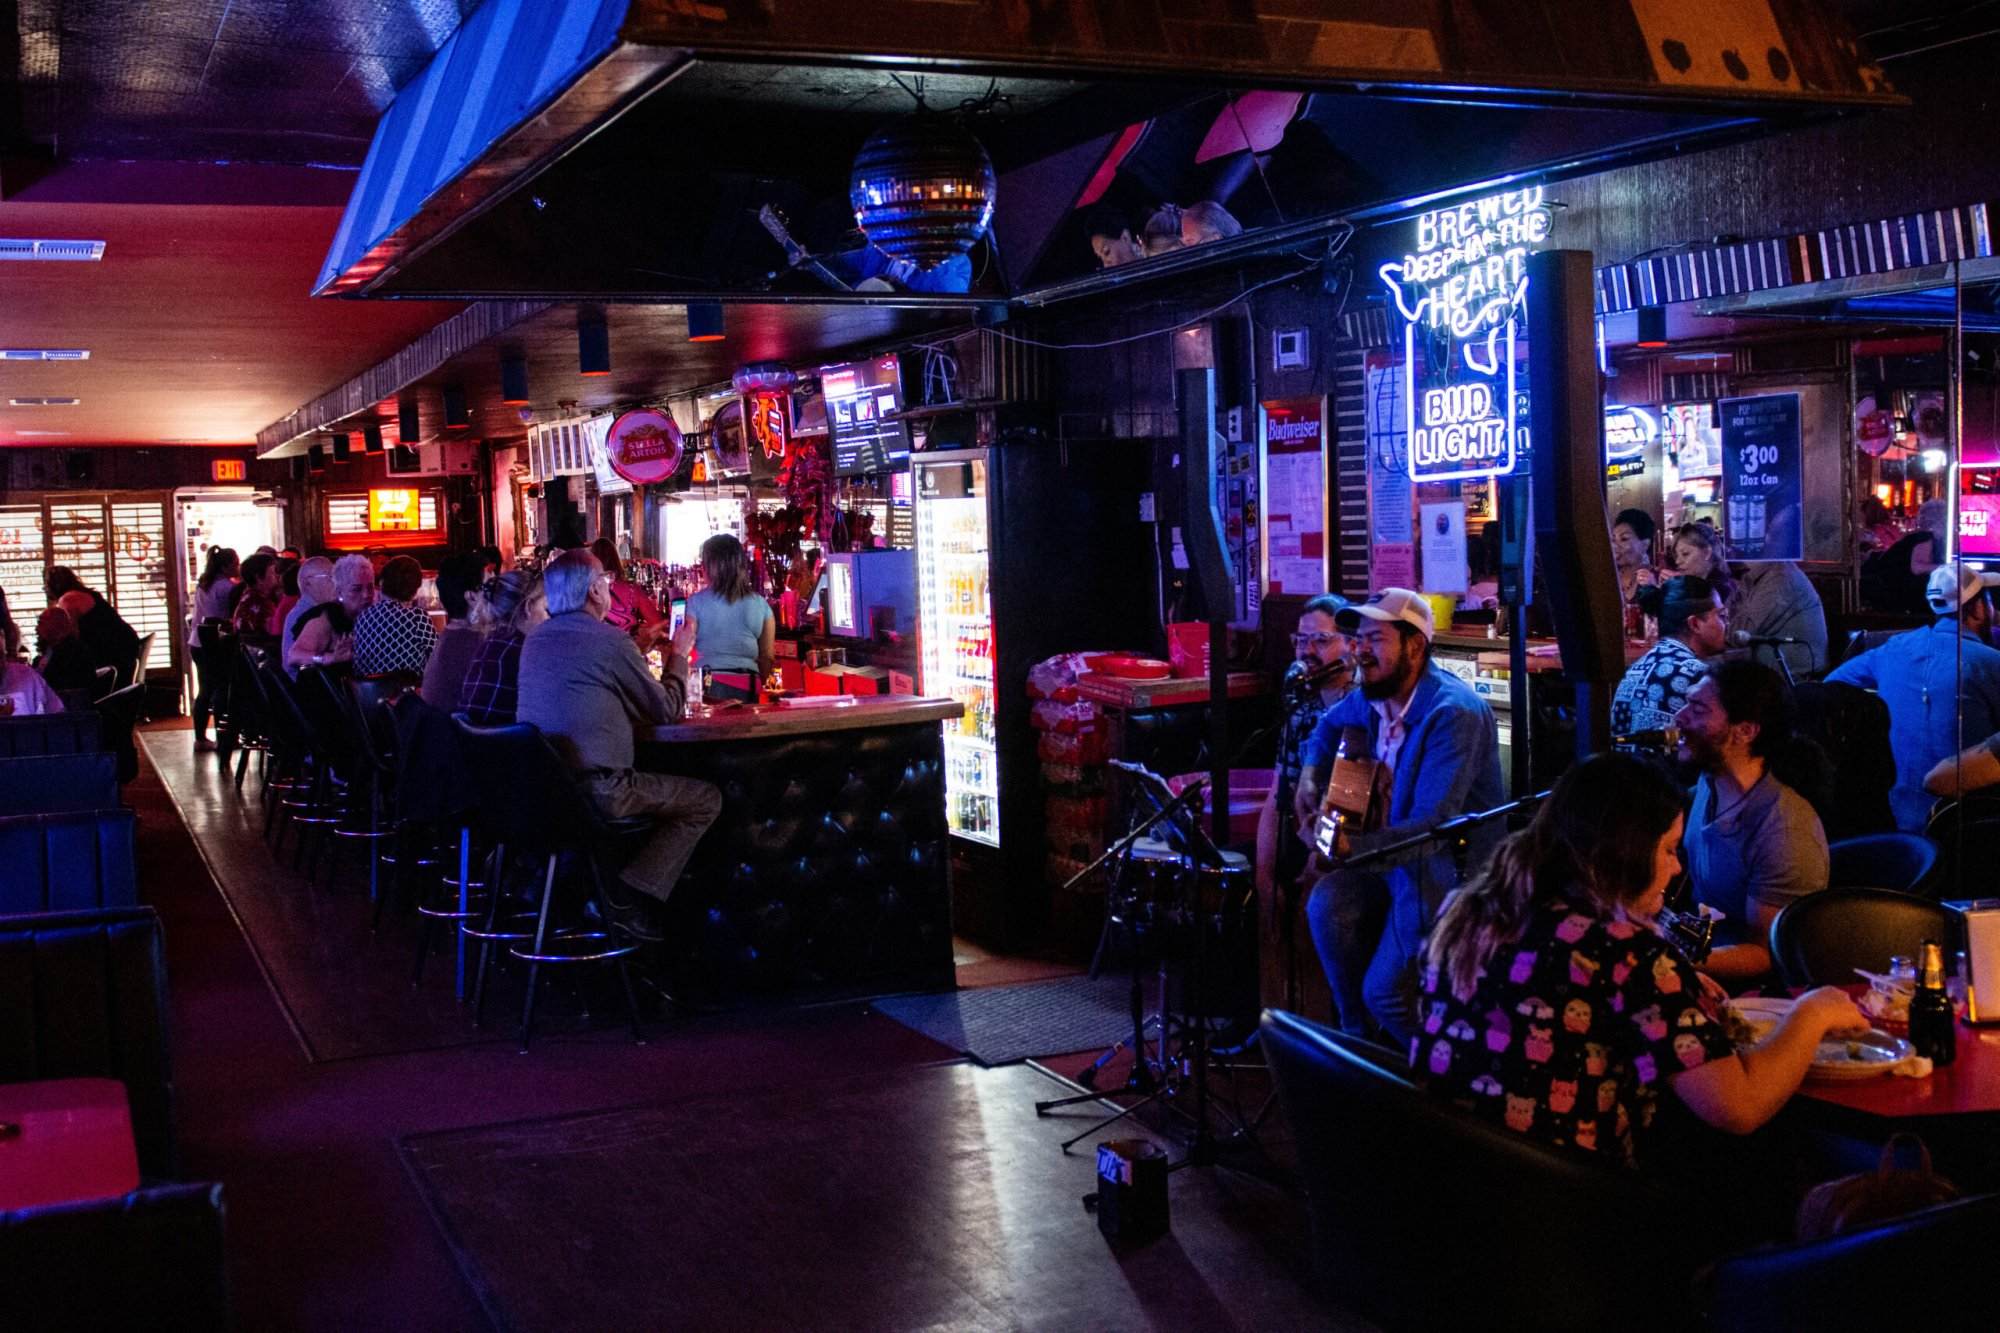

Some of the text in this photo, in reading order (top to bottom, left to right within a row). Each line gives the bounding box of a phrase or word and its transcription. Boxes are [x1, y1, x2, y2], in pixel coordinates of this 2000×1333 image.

[1417, 185, 1543, 253] BREWED
[1402, 247, 1456, 282] DEEP
[1497, 212, 1547, 246] THE
[1429, 247, 1522, 329] HEART
[1424, 383, 1492, 427] BUD
[627, 437, 665, 450] STELLA
[1268, 416, 1320, 441] Budweiser
[1415, 419, 1505, 466] LIGHT
[217, 461, 242, 480] EXIT
[1740, 473, 1779, 487] 12oz Can
